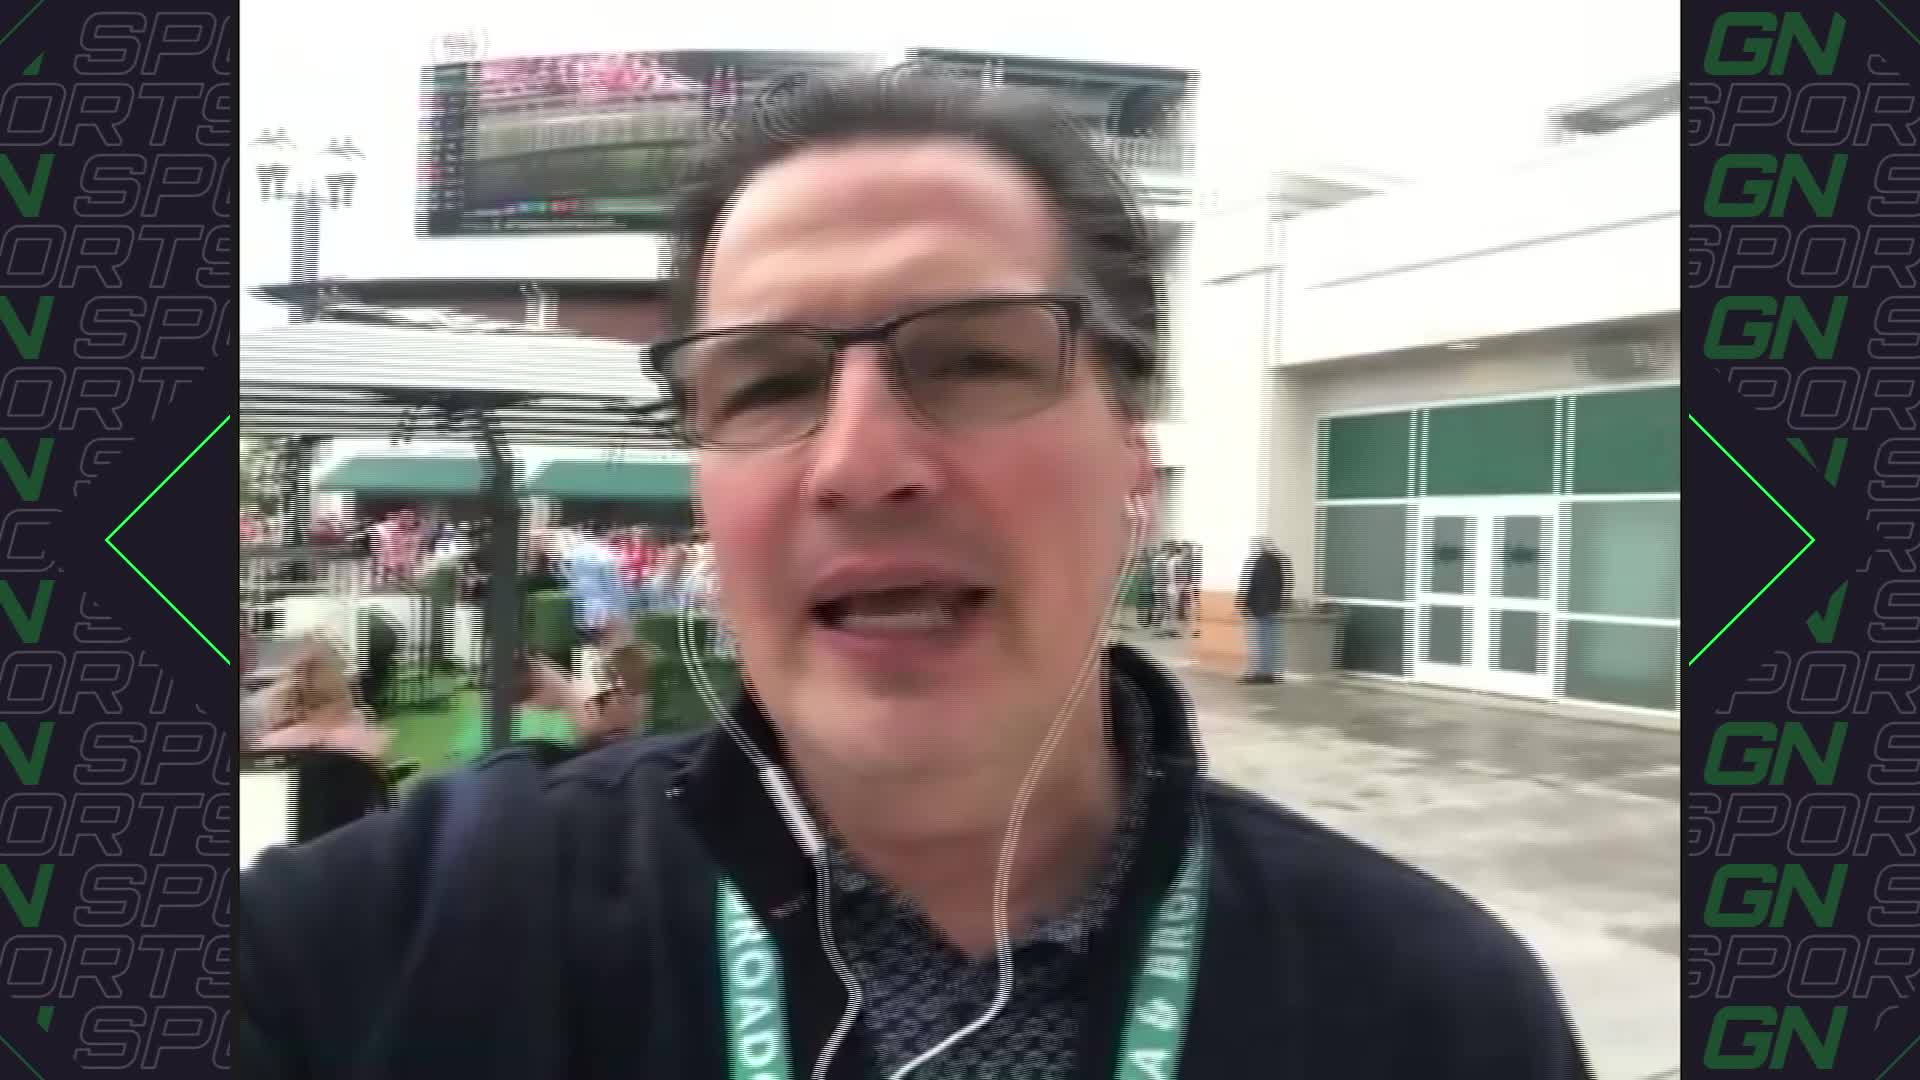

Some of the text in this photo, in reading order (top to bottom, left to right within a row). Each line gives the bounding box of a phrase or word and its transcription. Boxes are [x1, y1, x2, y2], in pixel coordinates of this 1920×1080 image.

[1143, 846, 1202, 983] BRO
[728, 891, 779, 1080] ROAD
[1136, 997, 1178, 1031] &
